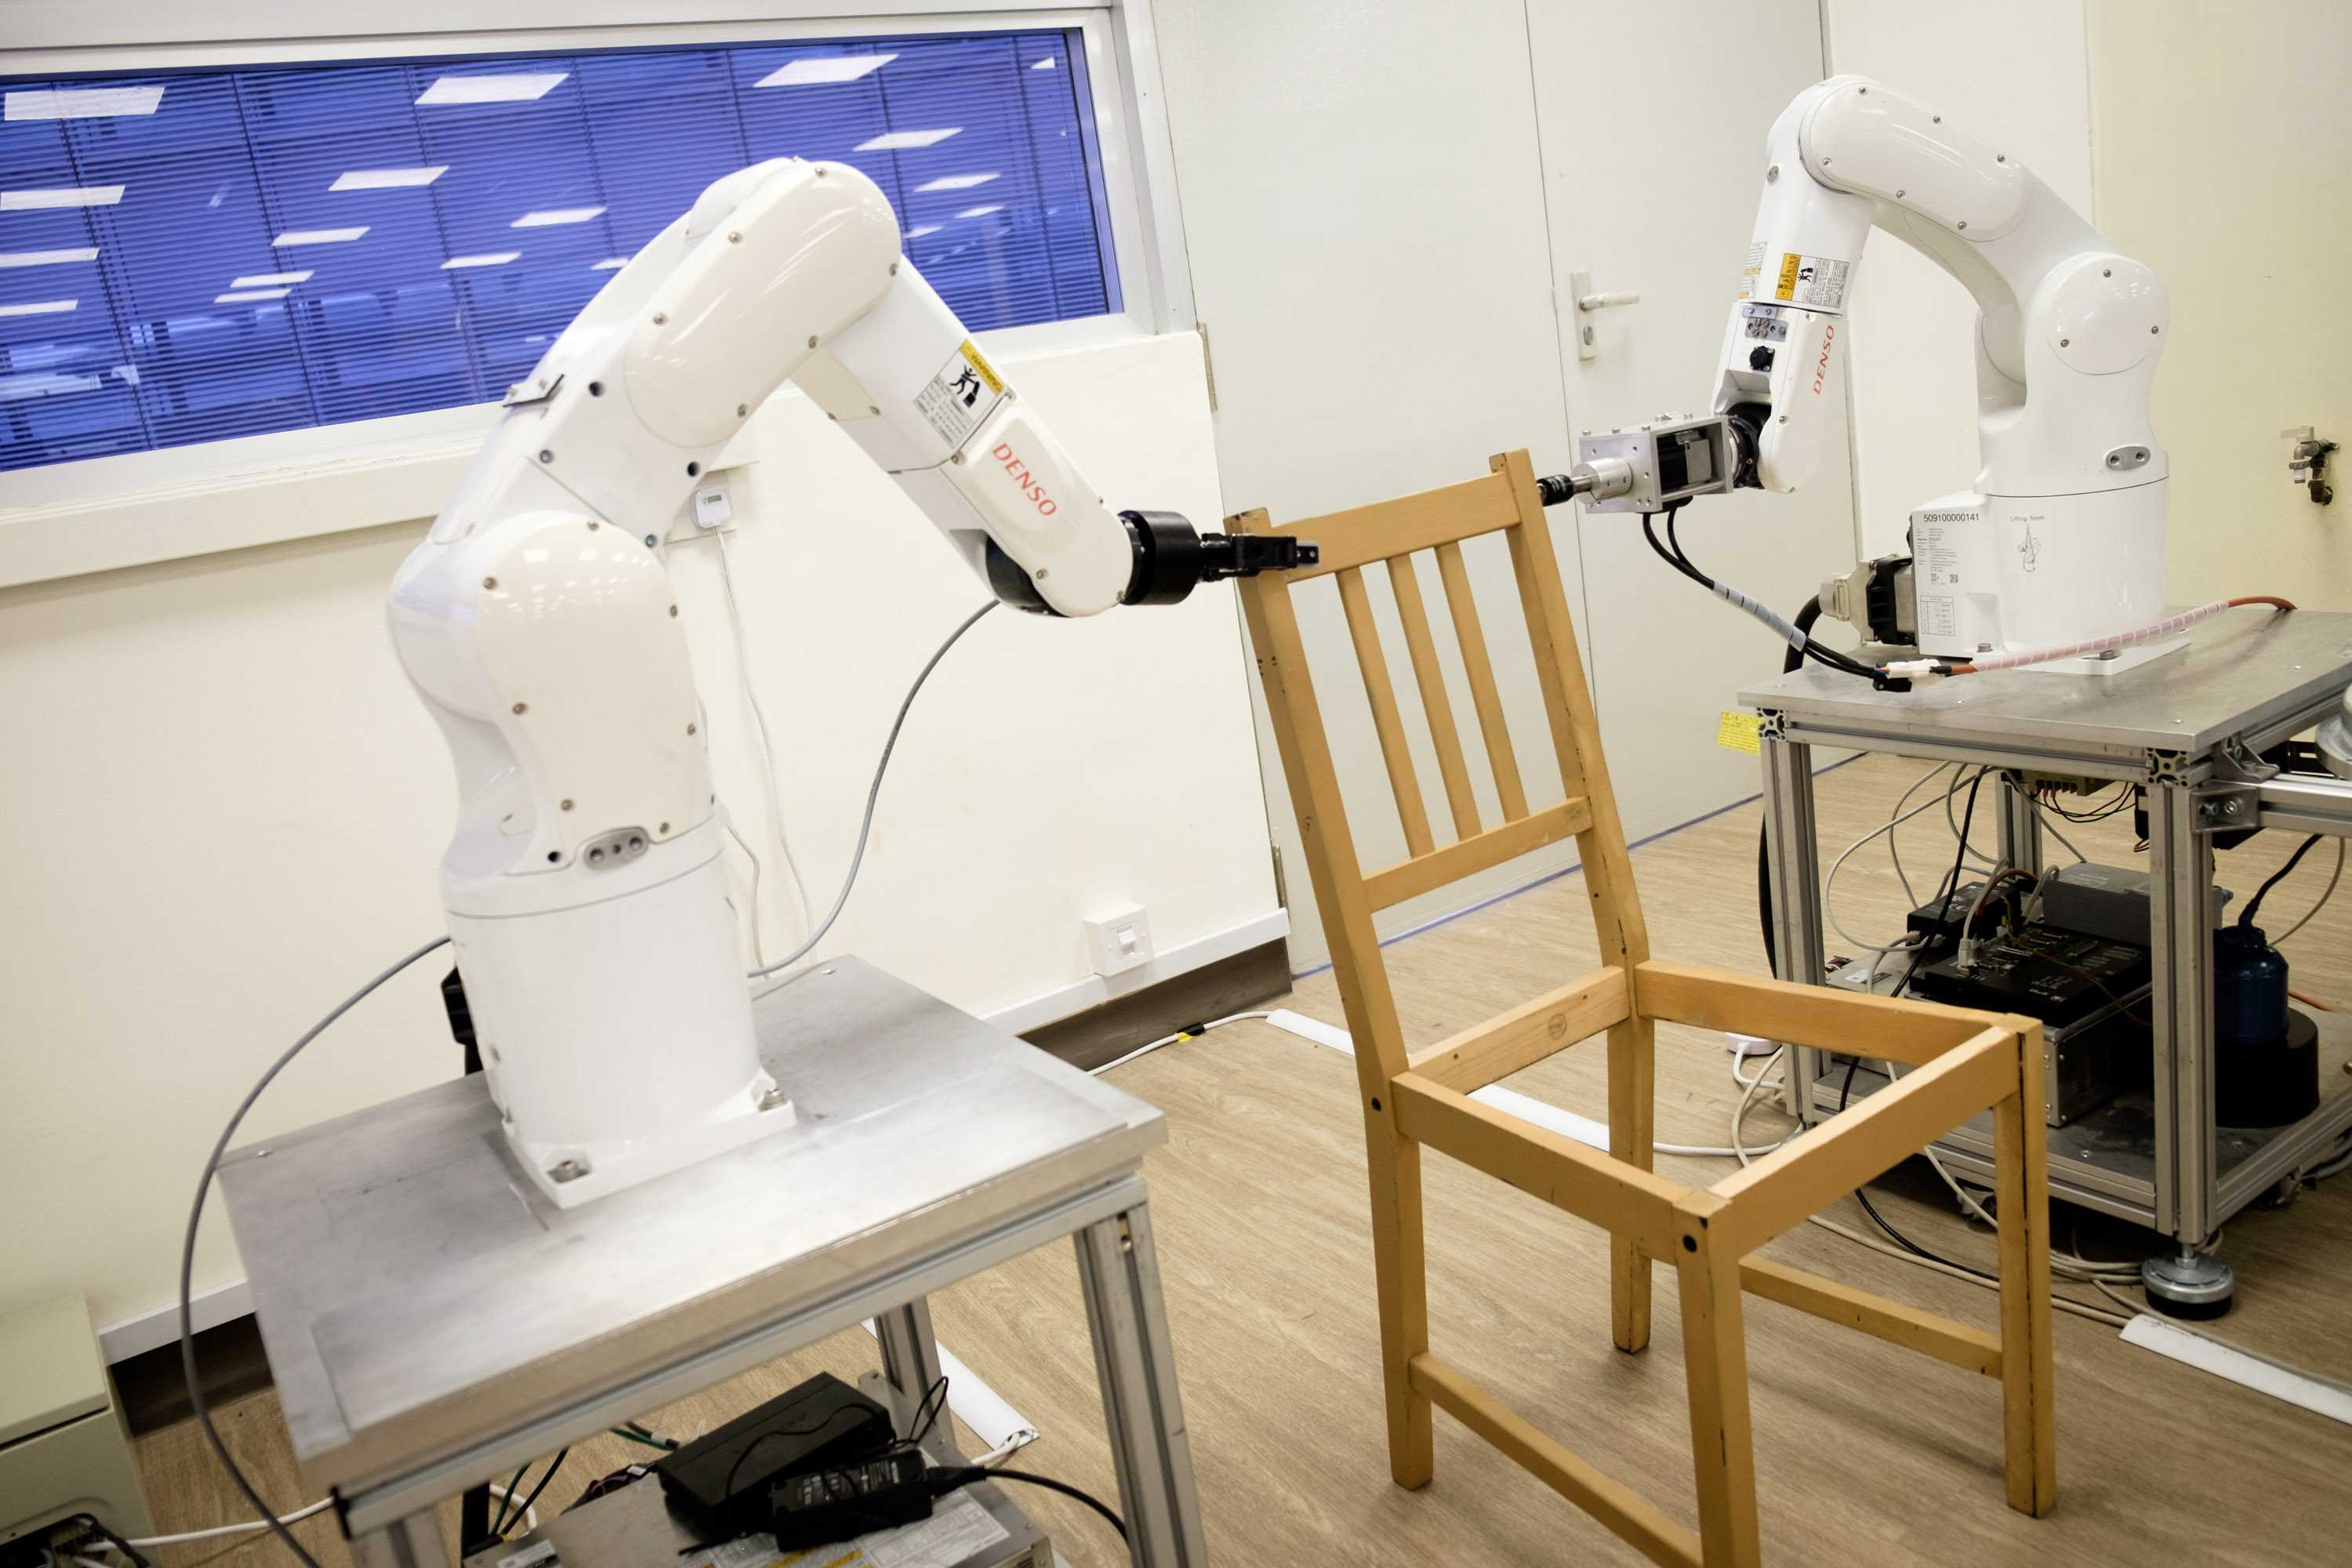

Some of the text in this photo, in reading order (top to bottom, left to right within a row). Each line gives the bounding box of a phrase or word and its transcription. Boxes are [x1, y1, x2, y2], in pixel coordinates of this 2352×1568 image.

[1813, 325, 1834, 394] DENSO
[993, 443, 1056, 515] DENSO
[1923, 514, 1979, 522] 509100000141
